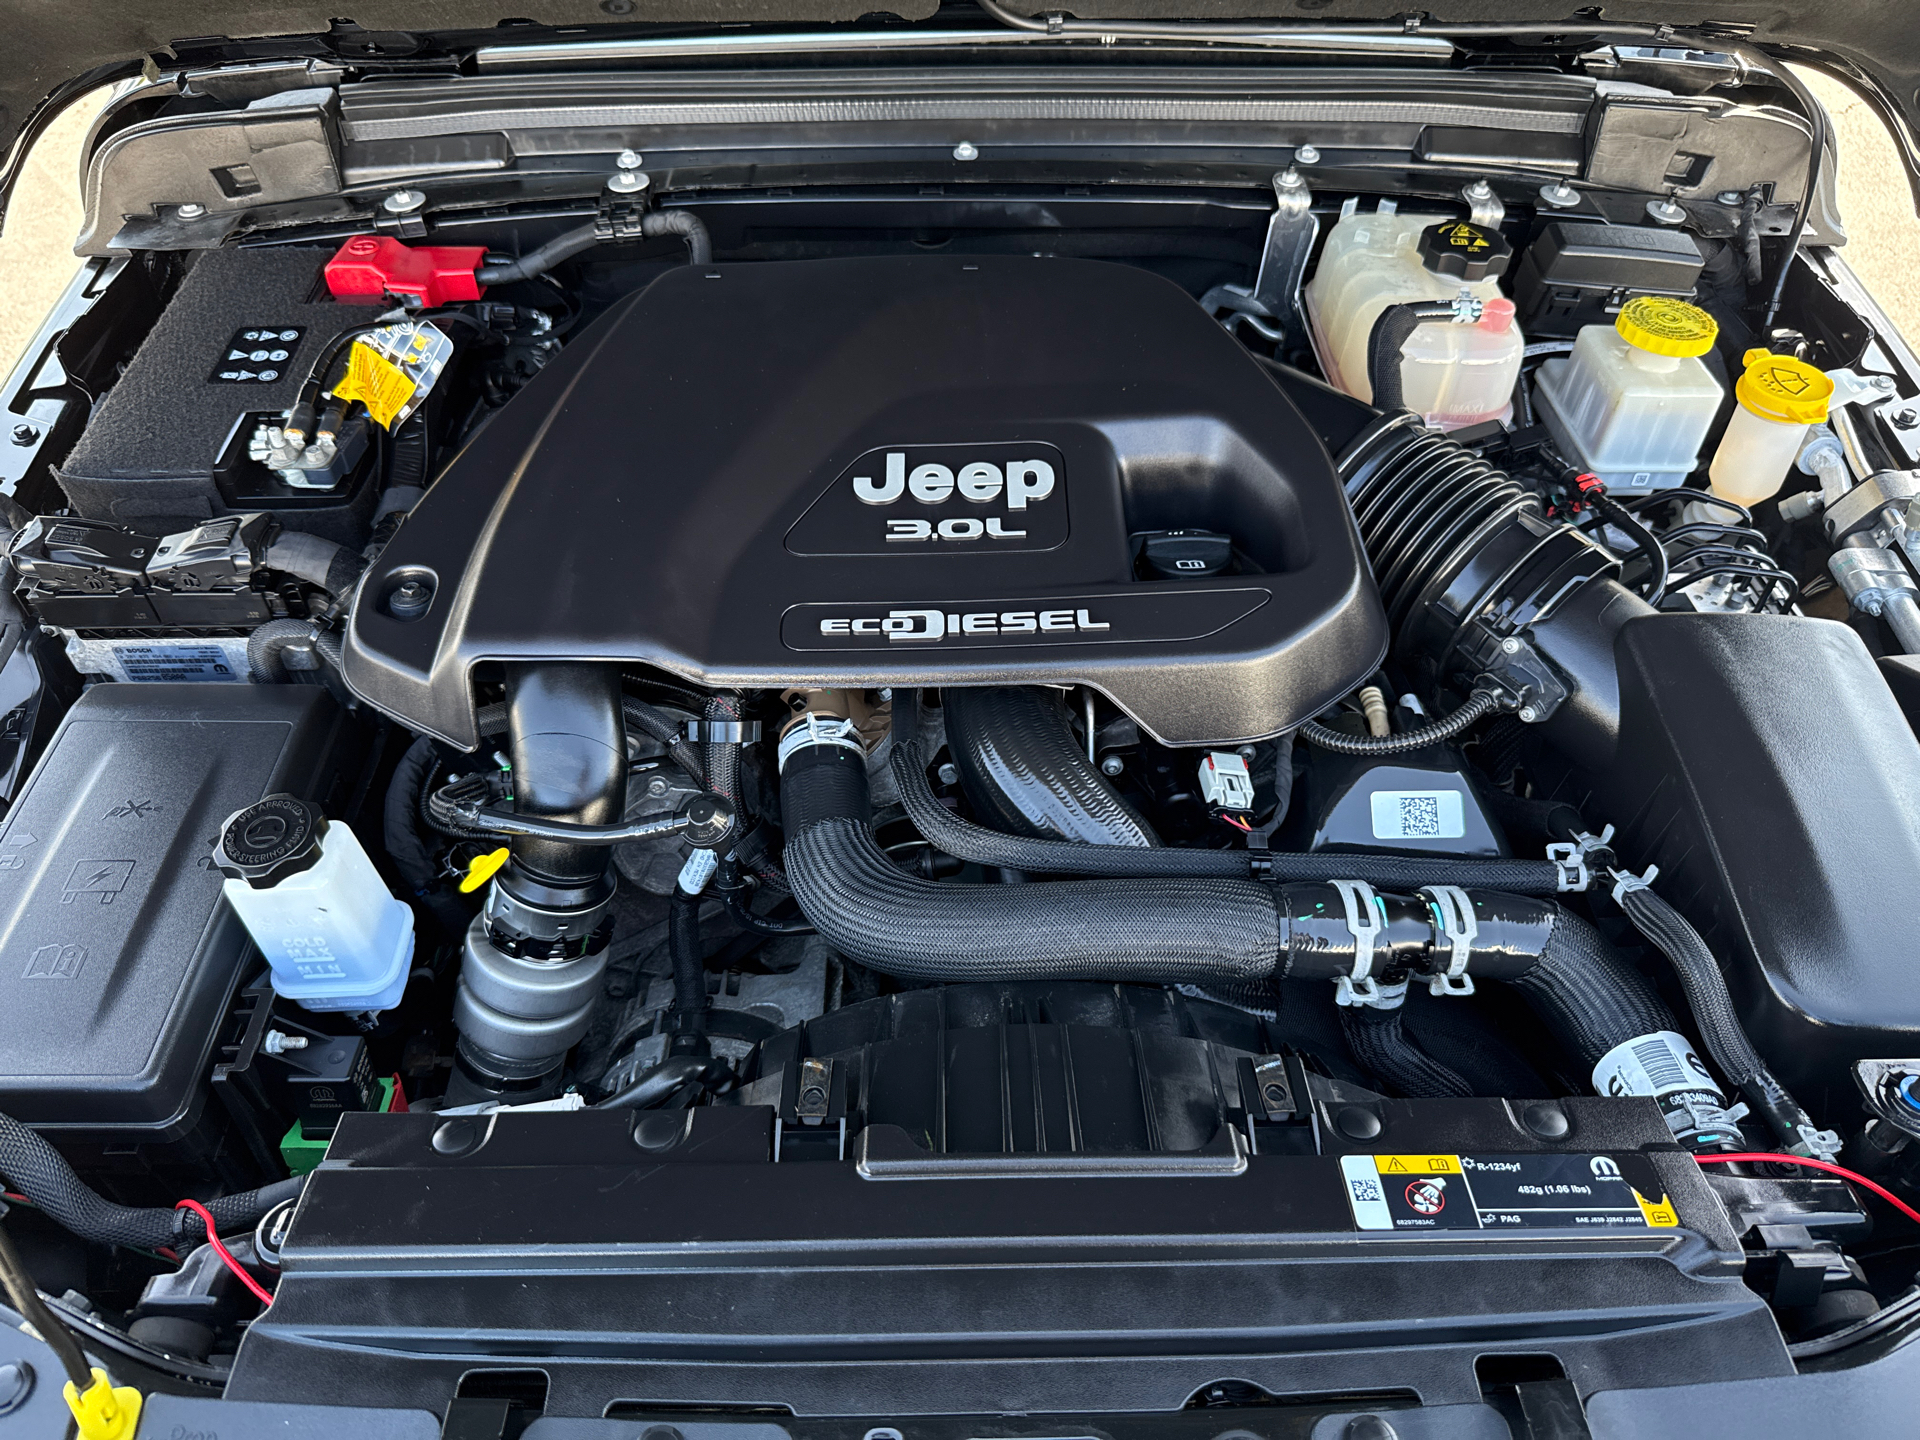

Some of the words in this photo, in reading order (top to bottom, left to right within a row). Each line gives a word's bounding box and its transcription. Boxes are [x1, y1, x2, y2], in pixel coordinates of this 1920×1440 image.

[852, 452, 1055, 511] Jeep
[885, 517, 1027, 542] 3.0L
[820, 608, 1111, 643] ECODIESEL
[238, 807, 258, 822] USE
[258, 800, 303, 816] APPROVED
[285, 825, 306, 849] FLUID
[282, 936, 326, 948] COLD
[286, 947, 333, 958] MAX
[297, 964, 342, 975] MIN
[1476, 1162, 1522, 1172] R-1234yf
[1517, 1185, 1543, 1195] 482g
[1545, 1185, 1569, 1195] (1.06
[1571, 1185, 1592, 1195] lbs)
[1500, 1215, 1521, 1223] PAG
